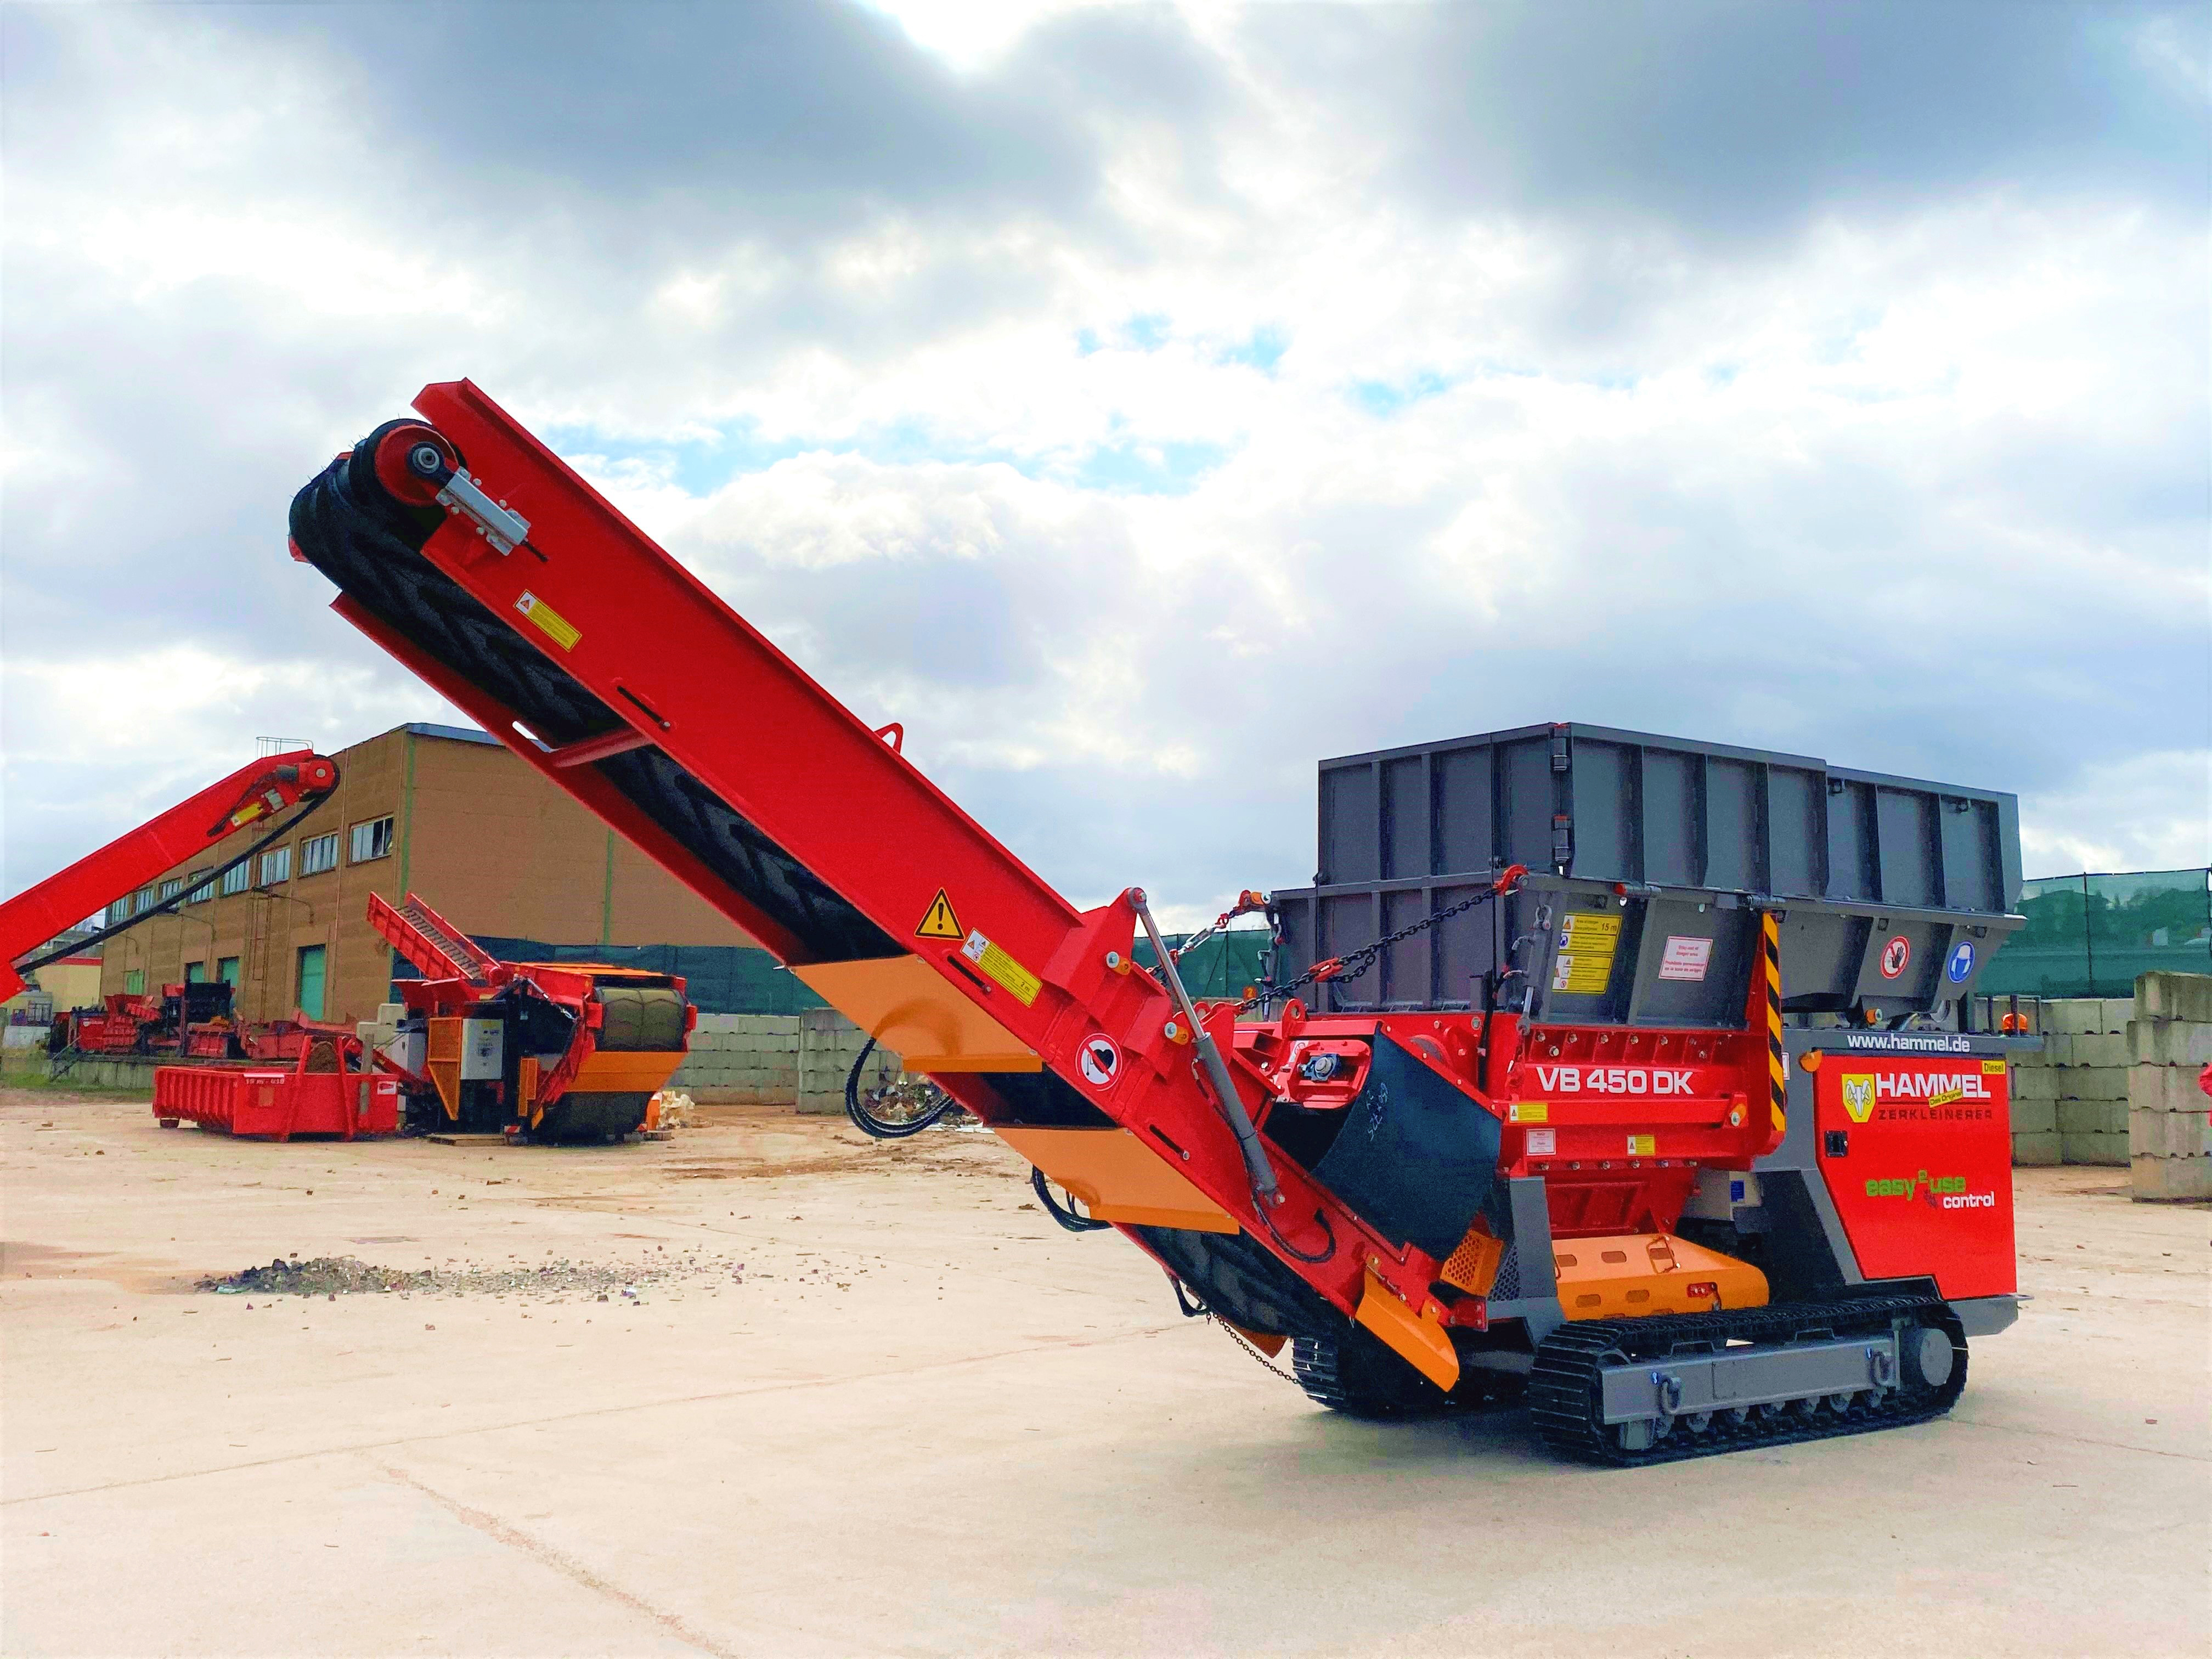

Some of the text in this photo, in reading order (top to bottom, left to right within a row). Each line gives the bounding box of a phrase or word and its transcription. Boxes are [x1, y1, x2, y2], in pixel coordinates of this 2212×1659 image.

[1602, 923, 1609, 931] 15
[1847, 1033, 1971, 1053] www.hammel.de
[1984, 1060, 2004, 1073] Diesel
[1536, 1066, 1694, 1094] VB 450 DK
[1876, 1073, 1991, 1098] HAMMEL
[1878, 1109, 1993, 1121] ZERKLEINERER
[1943, 1191, 1995, 1209] control
